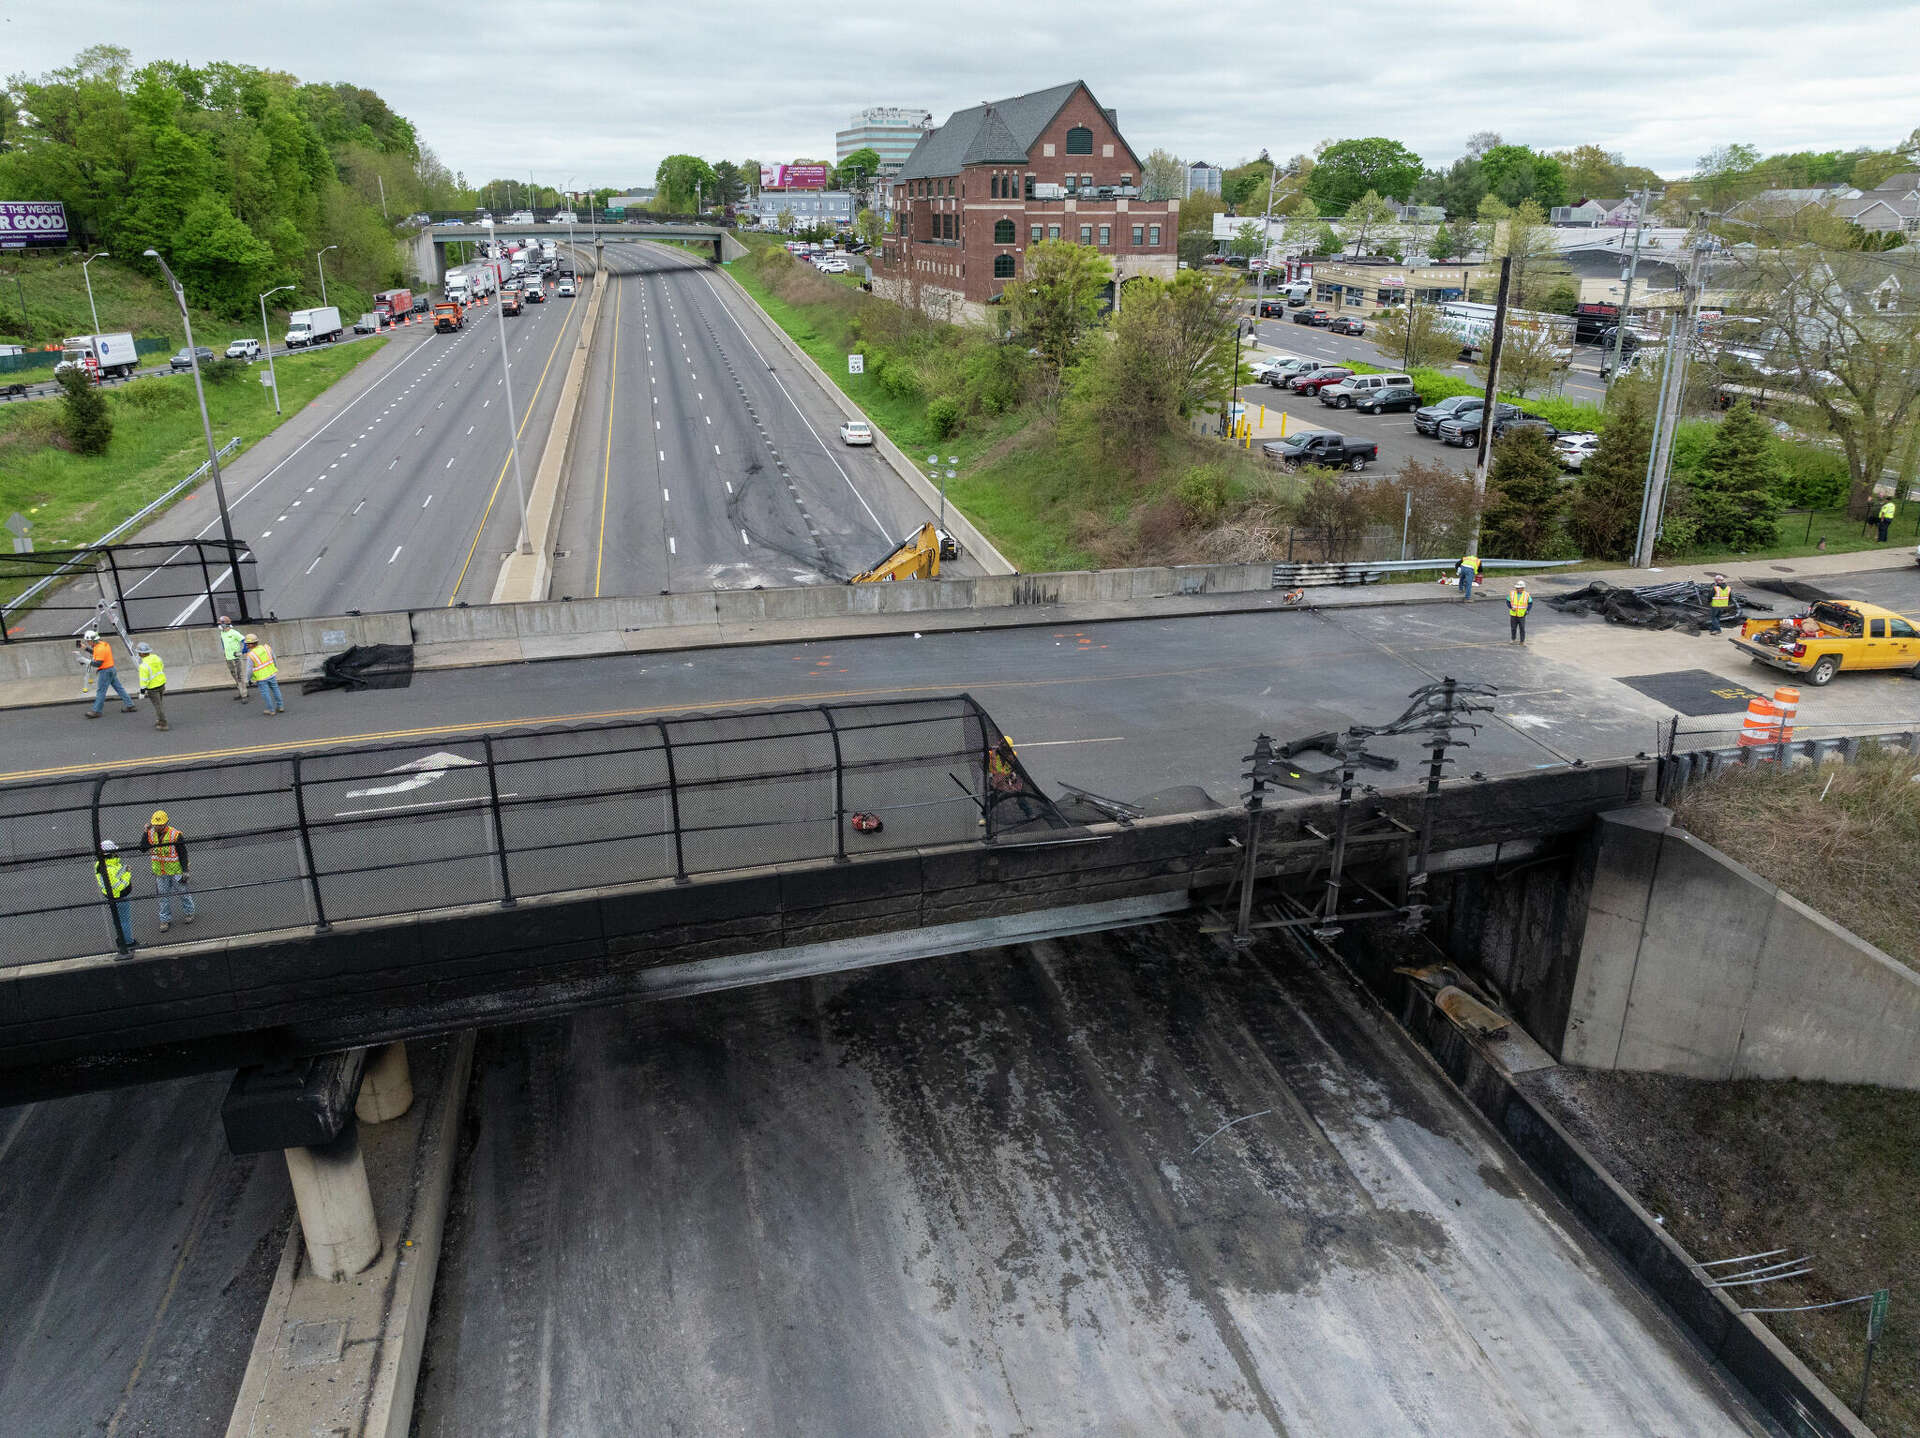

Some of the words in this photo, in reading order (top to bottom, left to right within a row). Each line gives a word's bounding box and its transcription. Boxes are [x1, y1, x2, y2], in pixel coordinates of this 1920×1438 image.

[6, 205, 26, 214] THE
[26, 205, 60, 214] WEIGHT
[13, 215, 64, 229] GOOD
